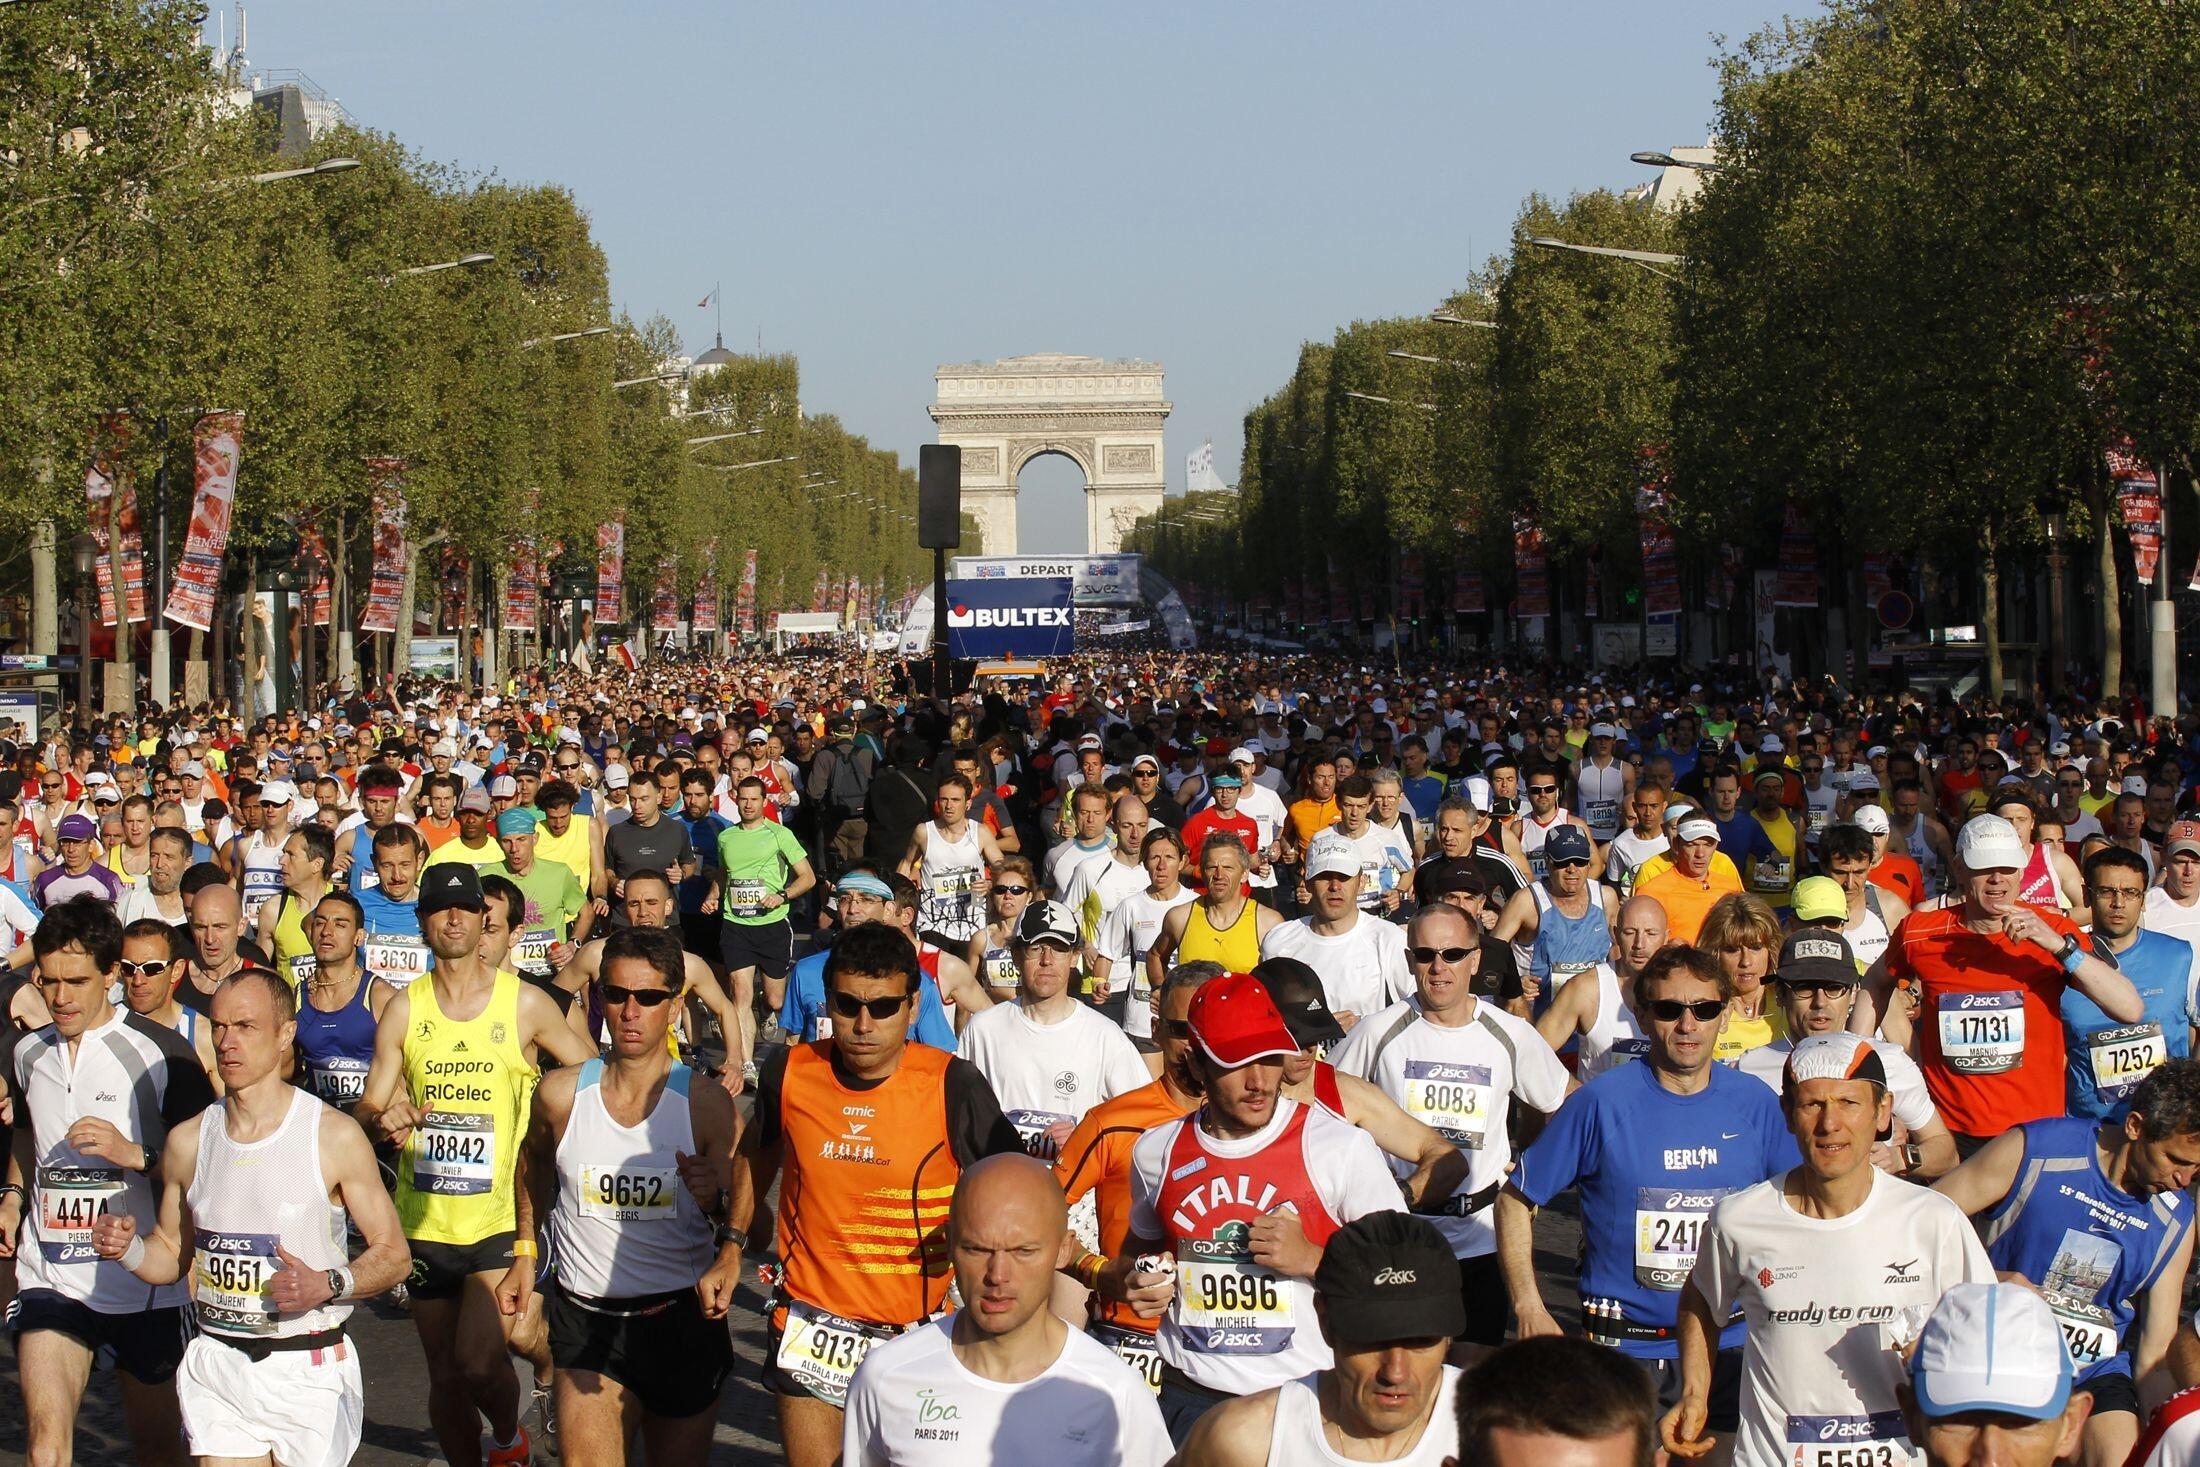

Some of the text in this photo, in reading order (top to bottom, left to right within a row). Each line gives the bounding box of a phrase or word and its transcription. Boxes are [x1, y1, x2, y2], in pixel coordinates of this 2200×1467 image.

[975, 608, 1071, 627] BULTEX
[2183, 825, 2194, 837] B
[737, 890, 760, 904] 8956
[380, 949, 418, 970] 3630
[1960, 1016, 2010, 1044] 17131
[2098, 1030, 2118, 1041] GDF
[1969, 1047, 1999, 1057] MAGNUS
[2109, 1045, 2155, 1074] 7252
[425, 1060, 494, 1077] Sapporo
[1954, 1057, 1979, 1067] GDF
[425, 1083, 492, 1101] RICelec
[1424, 1083, 1477, 1115] 8083
[425, 1113, 446, 1124] GDF
[842, 1105, 876, 1118] amic
[1432, 1115, 1459, 1127] PATRICK
[427, 1134, 485, 1164] 18842
[49, 1171, 68, 1181] GDF
[440, 1166, 462, 1176] JAVIER
[600, 1173, 662, 1207] 9652
[2075, 1191, 2115, 1216] Marathon
[2115, 1211, 2126, 1221] de
[615, 1211, 639, 1221] REGIS
[2088, 1208, 2109, 1223] Avril
[68, 1232, 93, 1243] PIERR
[1655, 1218, 1706, 1252] 241
[1193, 1241, 1224, 1255] GDF
[209, 1256, 260, 1292] 9651
[1651, 1270, 1681, 1282] GDF
[1201, 1273, 1278, 1311] 9696
[216, 1293, 246, 1308] LAURENT
[1767, 1301, 1895, 1326] ready to run
[1215, 1316, 1257, 1328] MICHELE
[801, 1359, 831, 1380] ALBALA
[914, 1428, 960, 1441] PARIS 2011
